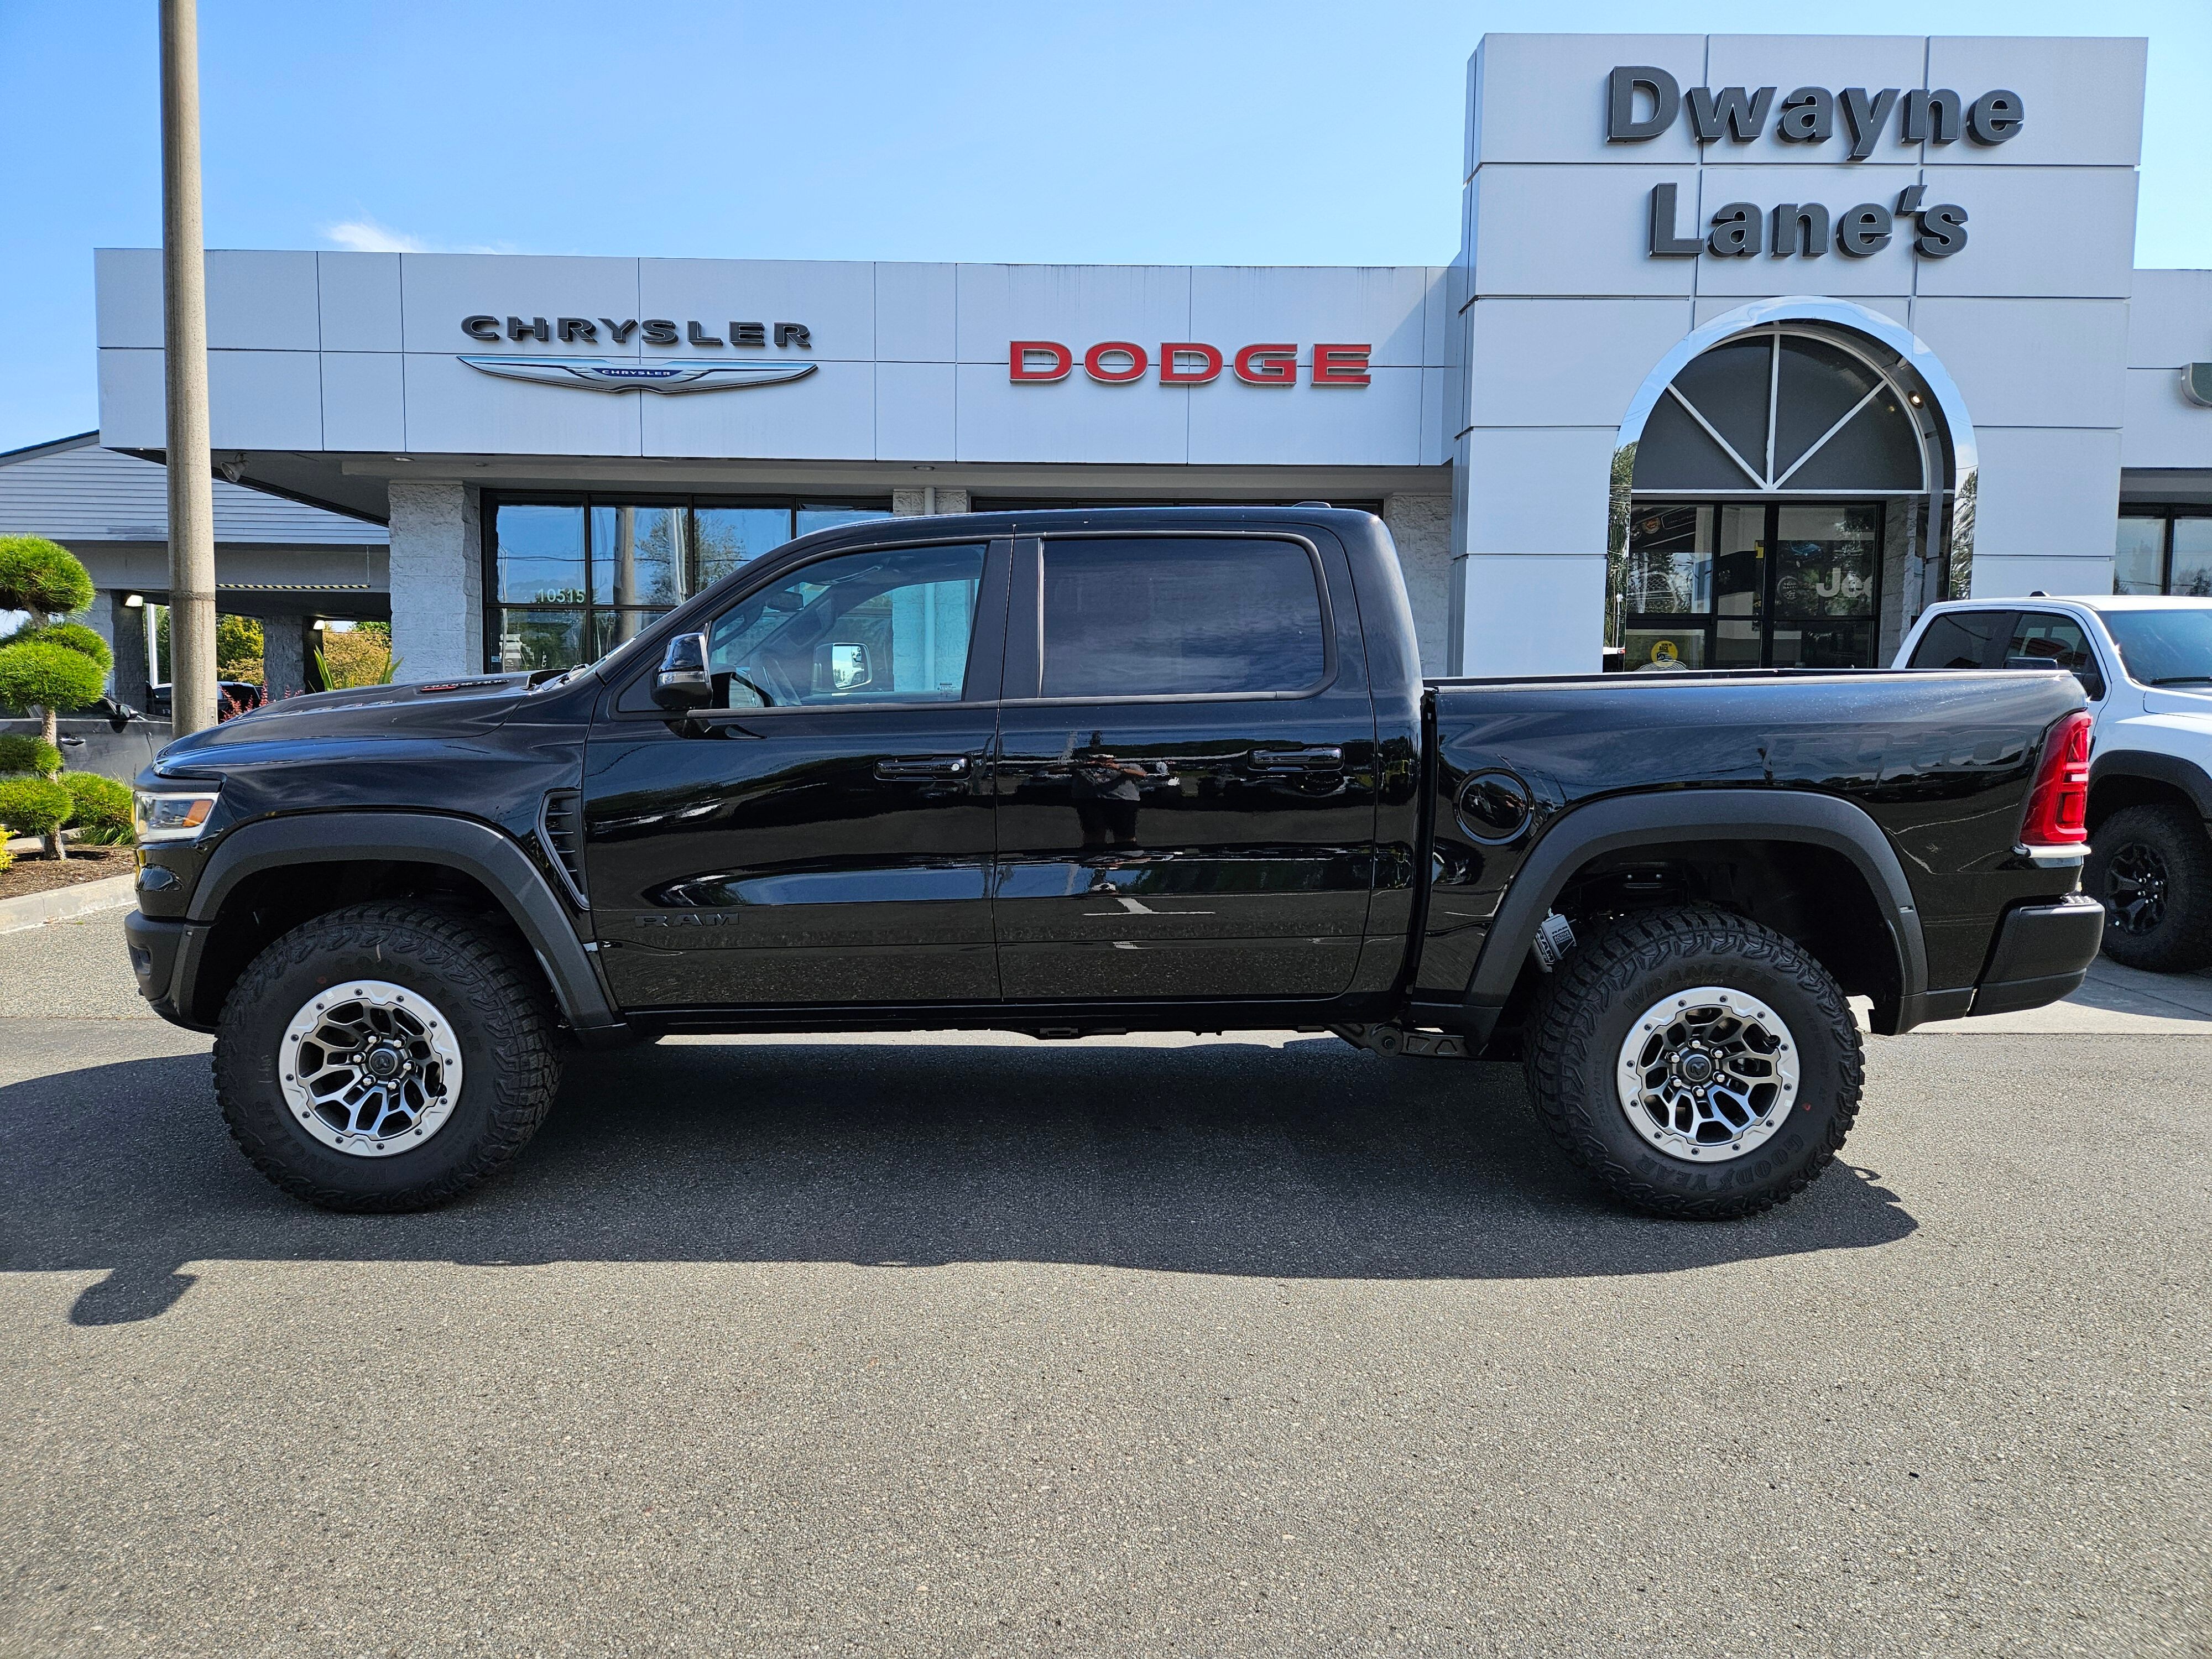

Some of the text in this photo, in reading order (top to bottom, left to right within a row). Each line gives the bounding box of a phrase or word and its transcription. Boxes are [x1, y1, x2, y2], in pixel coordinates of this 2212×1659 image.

[1607, 65, 2025, 161] Dwayne
[1649, 182, 1969, 259] Lane's
[460, 315, 812, 348] CHRYSLER
[1009, 341, 1372, 387] DODGE
[539, 588, 585, 603] 10515
[635, 913, 739, 928] RAM
[1636, 1133, 1804, 1191] GOODYEAR
